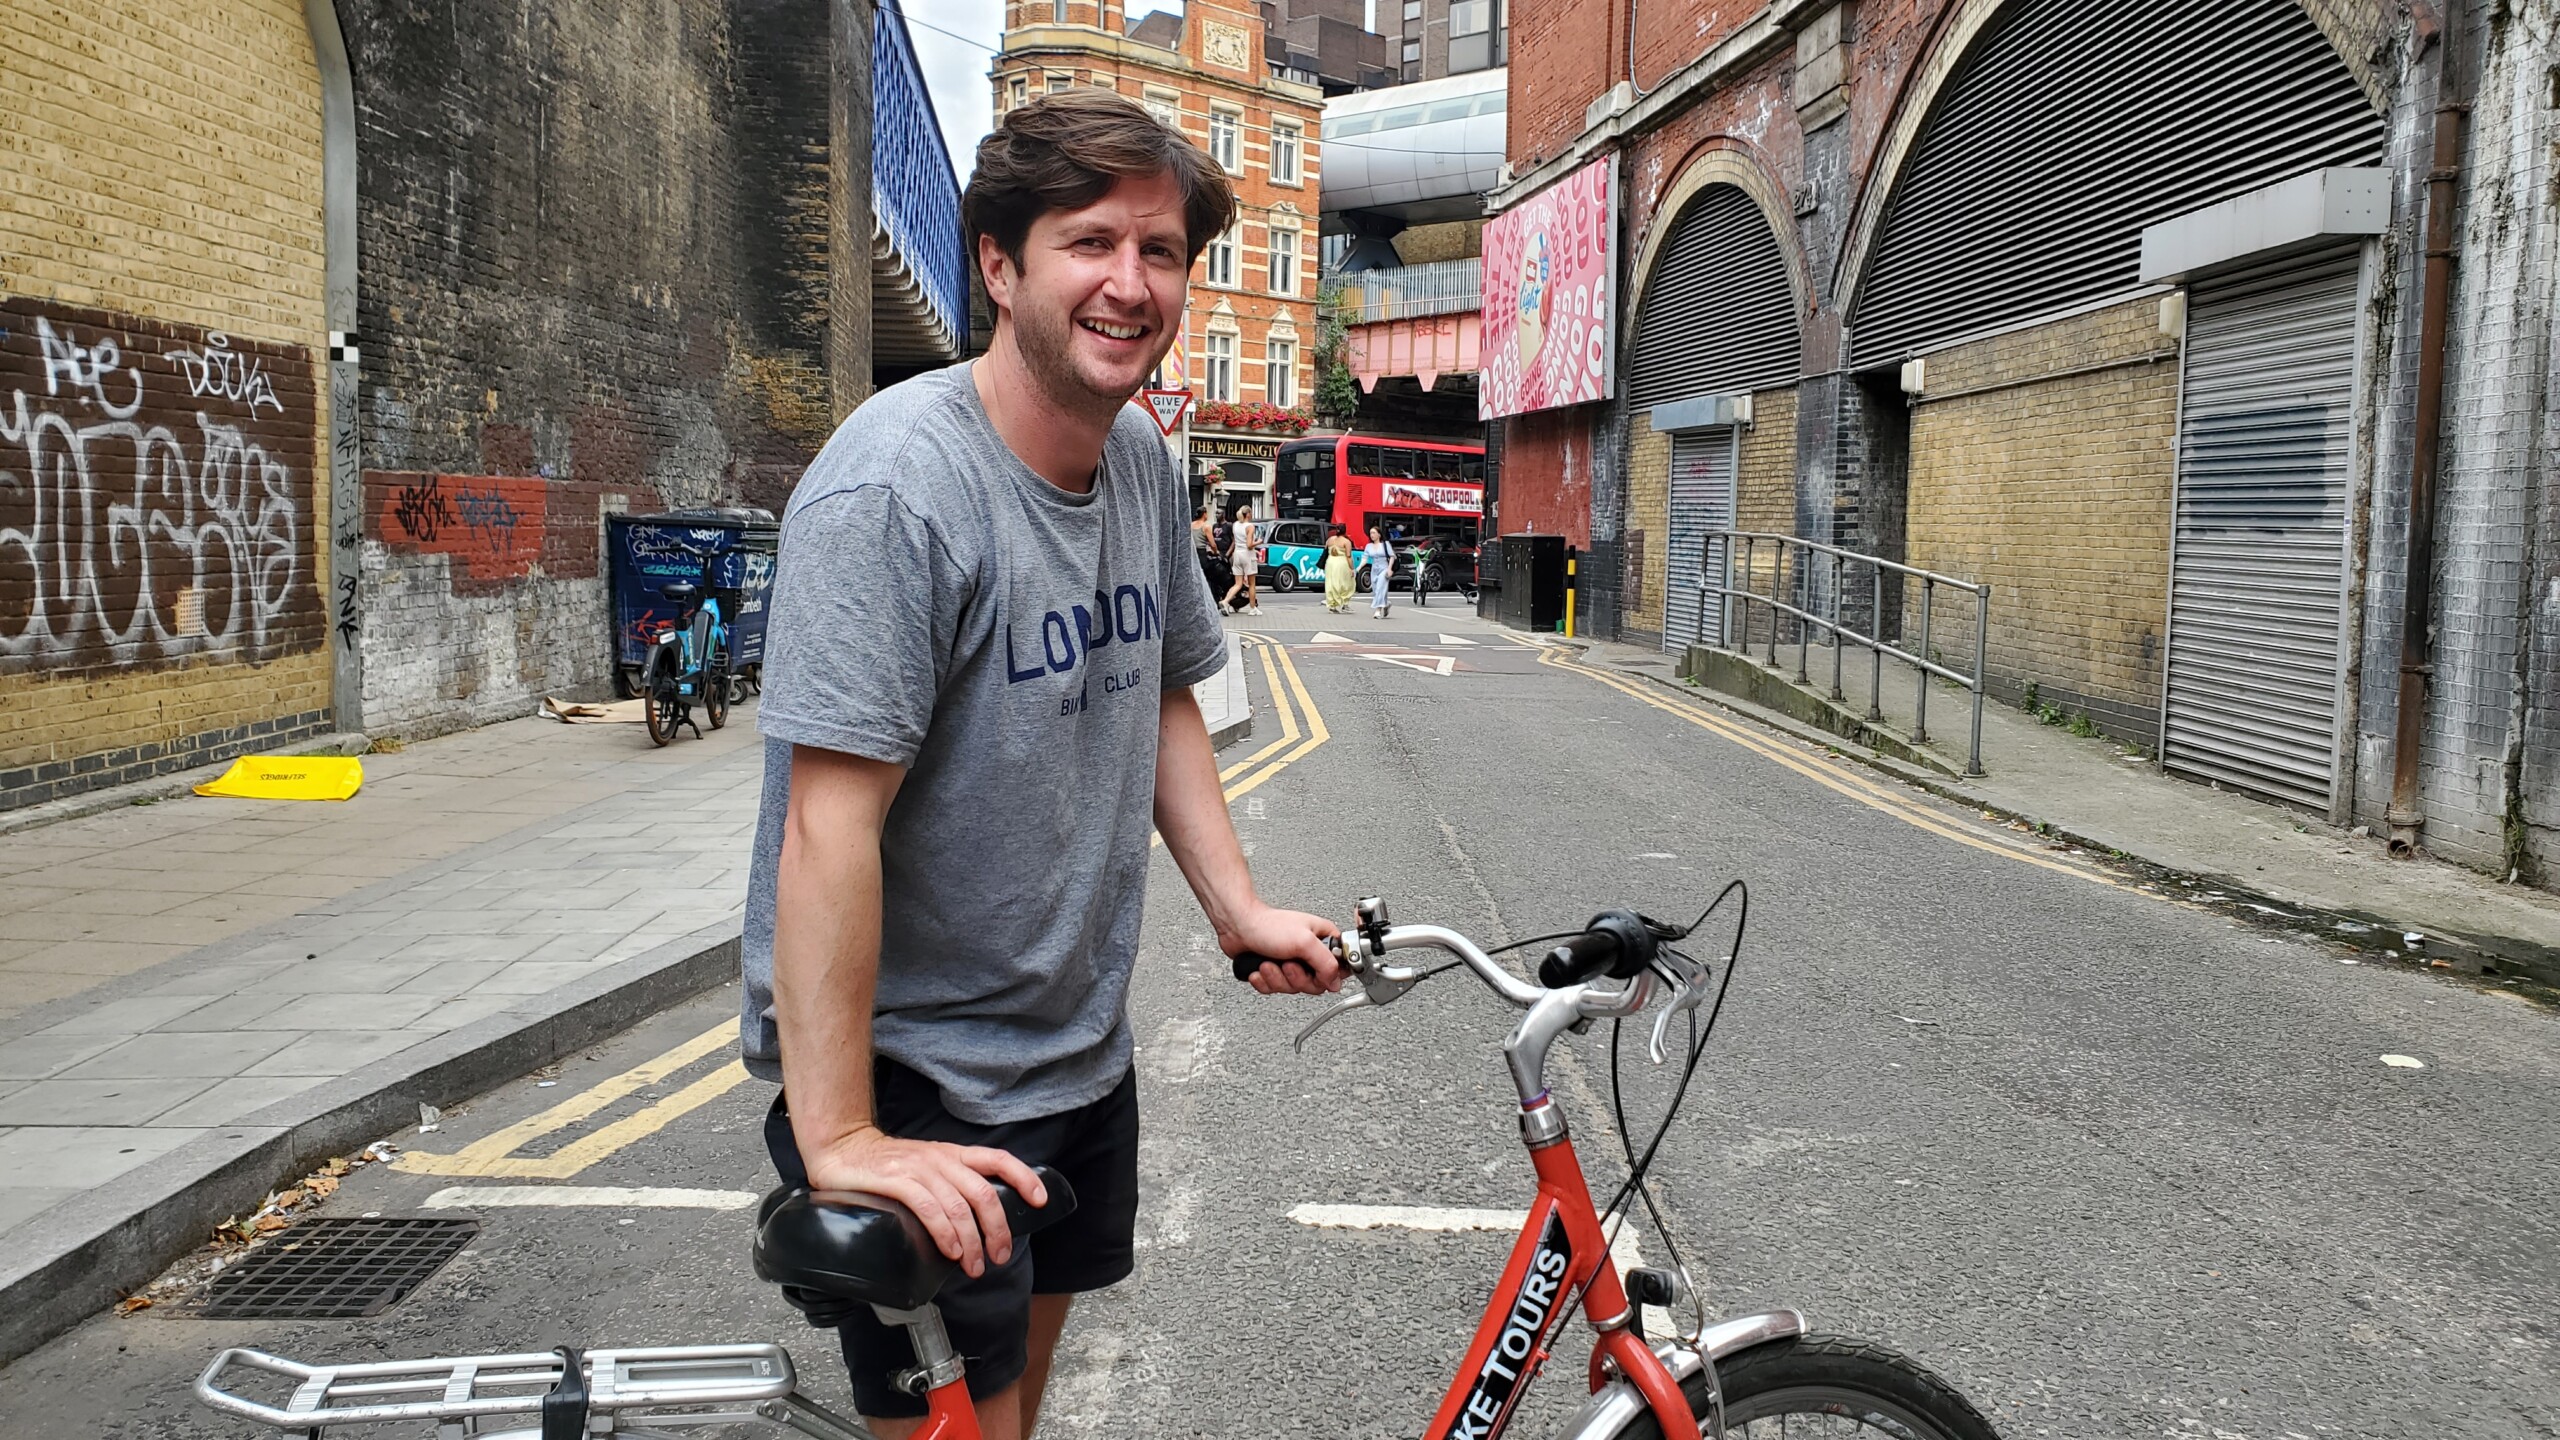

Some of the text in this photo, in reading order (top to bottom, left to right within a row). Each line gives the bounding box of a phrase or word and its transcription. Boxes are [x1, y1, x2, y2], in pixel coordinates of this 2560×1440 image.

[1523, 206, 1538, 238] GET
[1519, 280, 1541, 315] light
[1521, 359, 1542, 400] GOING
[1152, 396, 1181, 407] GIVE
[1158, 408, 1177, 416] WAY
[1189, 440, 1214, 453] THE
[1428, 488, 1475, 505] DEADPOOL
[1104, 667, 1141, 693] CLUB
[1480, 1249, 1567, 1382] TOURS
